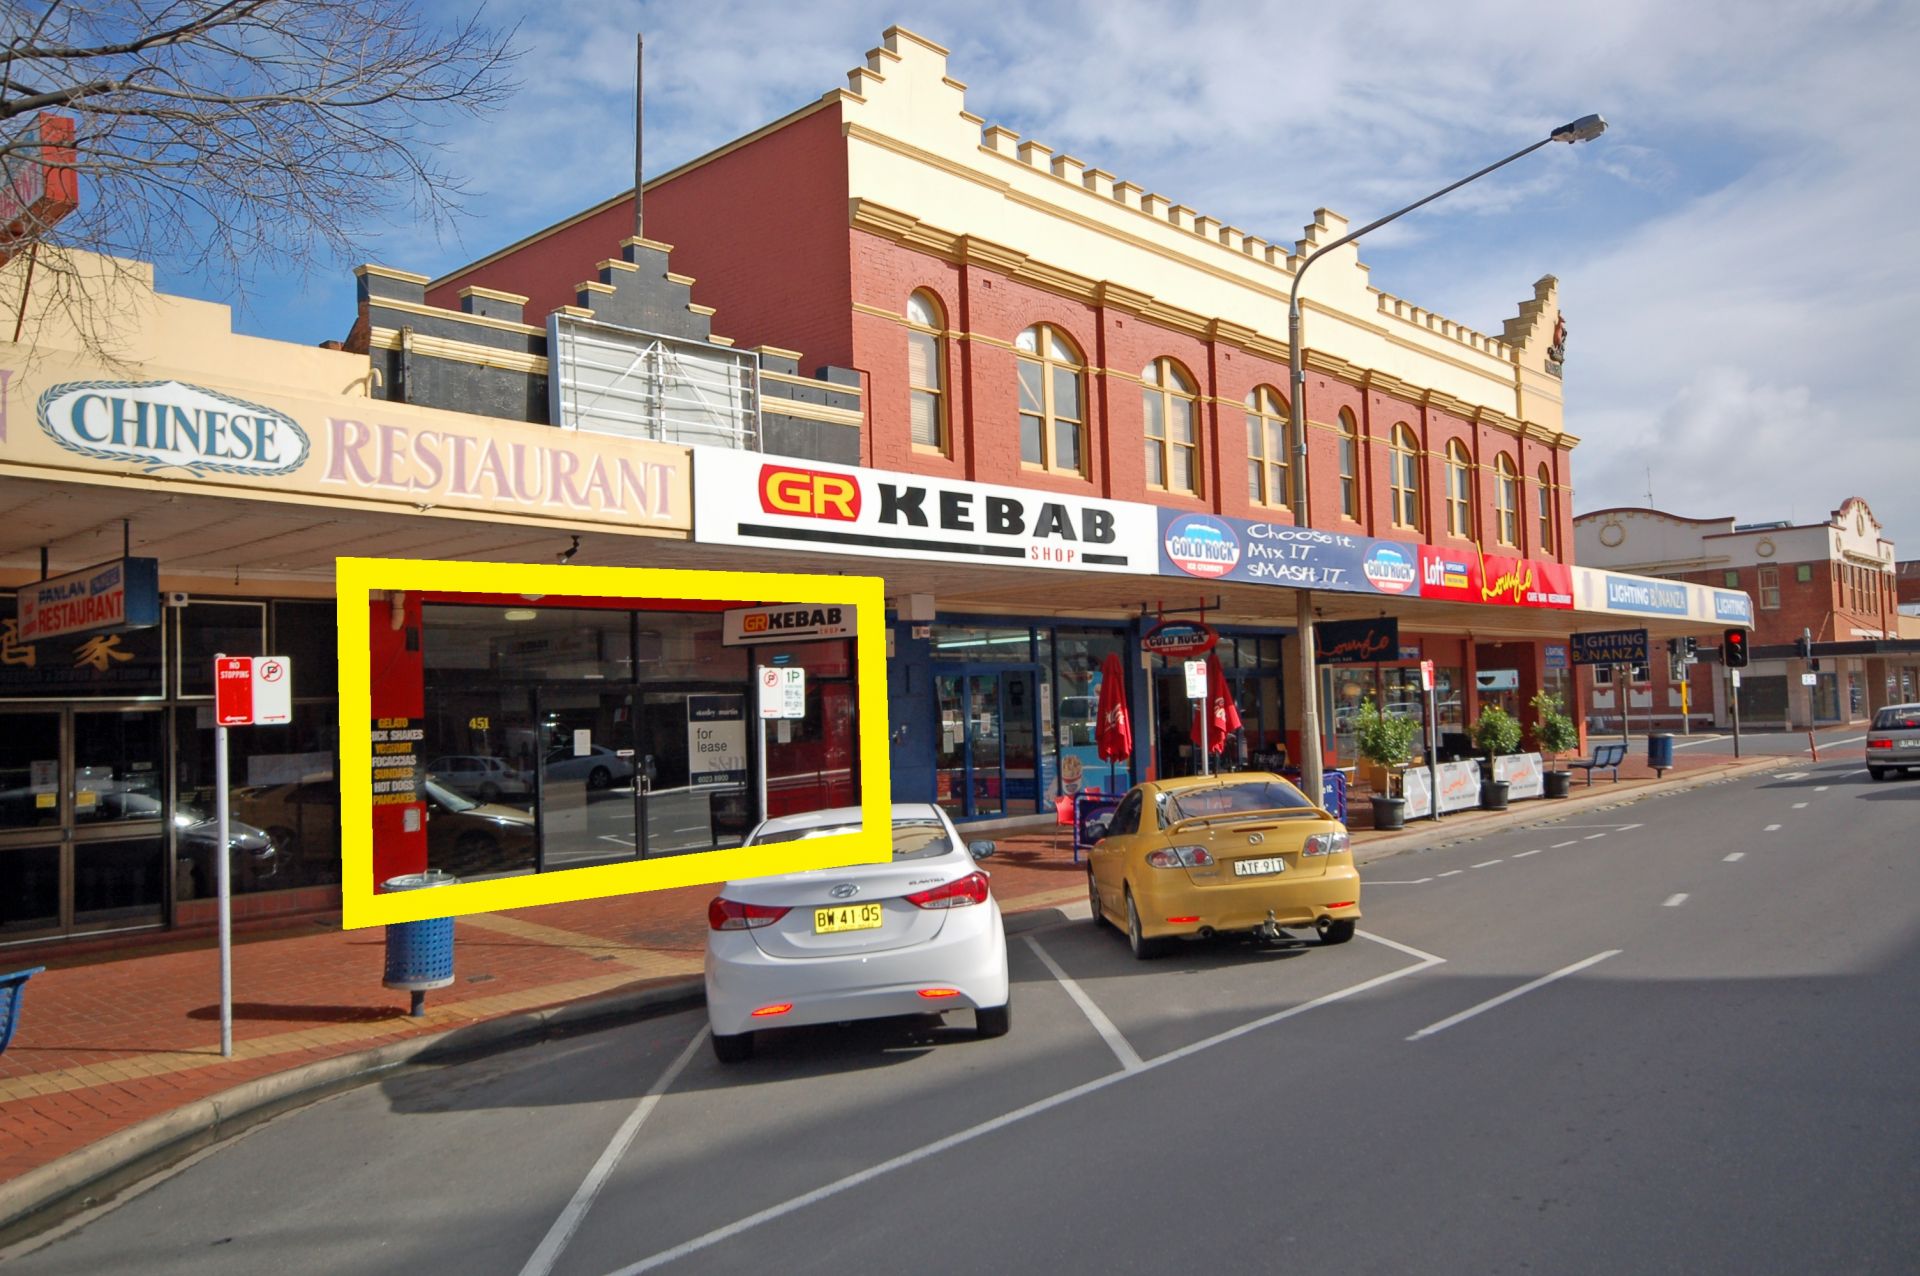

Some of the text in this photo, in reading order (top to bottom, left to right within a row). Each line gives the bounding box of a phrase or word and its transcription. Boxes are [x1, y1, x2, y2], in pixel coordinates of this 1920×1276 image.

[70, 393, 281, 464] CHINESE
[320, 417, 676, 520] RESTAURANT
[765, 471, 1116, 545] GR KEBAB
[1247, 523, 1332, 543] Choose
[1031, 545, 1075, 563] SHOP
[1171, 536, 1235, 562] COLD ROCK
[1247, 542, 1284, 560] Mix
[1367, 560, 1412, 580] COLD ROCK
[1423, 556, 1445, 586] Loft
[1609, 583, 1649, 605] LIGHTING
[38, 591, 123, 633] RESTAURANT
[744, 608, 842, 631] GR KEBAB
[1149, 632, 1205, 646] COLD ROCK
[1573, 633, 1644, 649] LIGHTING
[229, 661, 240, 669] NO
[220, 670, 250, 679] STOPPING
[787, 670, 800, 683] 1P
[378, 718, 408, 729] GELATO
[469, 717, 489, 729] 451
[390, 729, 424, 741] SHAKES
[697, 728, 713, 740] for
[697, 741, 728, 753] lease
[374, 780, 415, 793] HOT DOGS
[840, 909, 855, 924] 41
